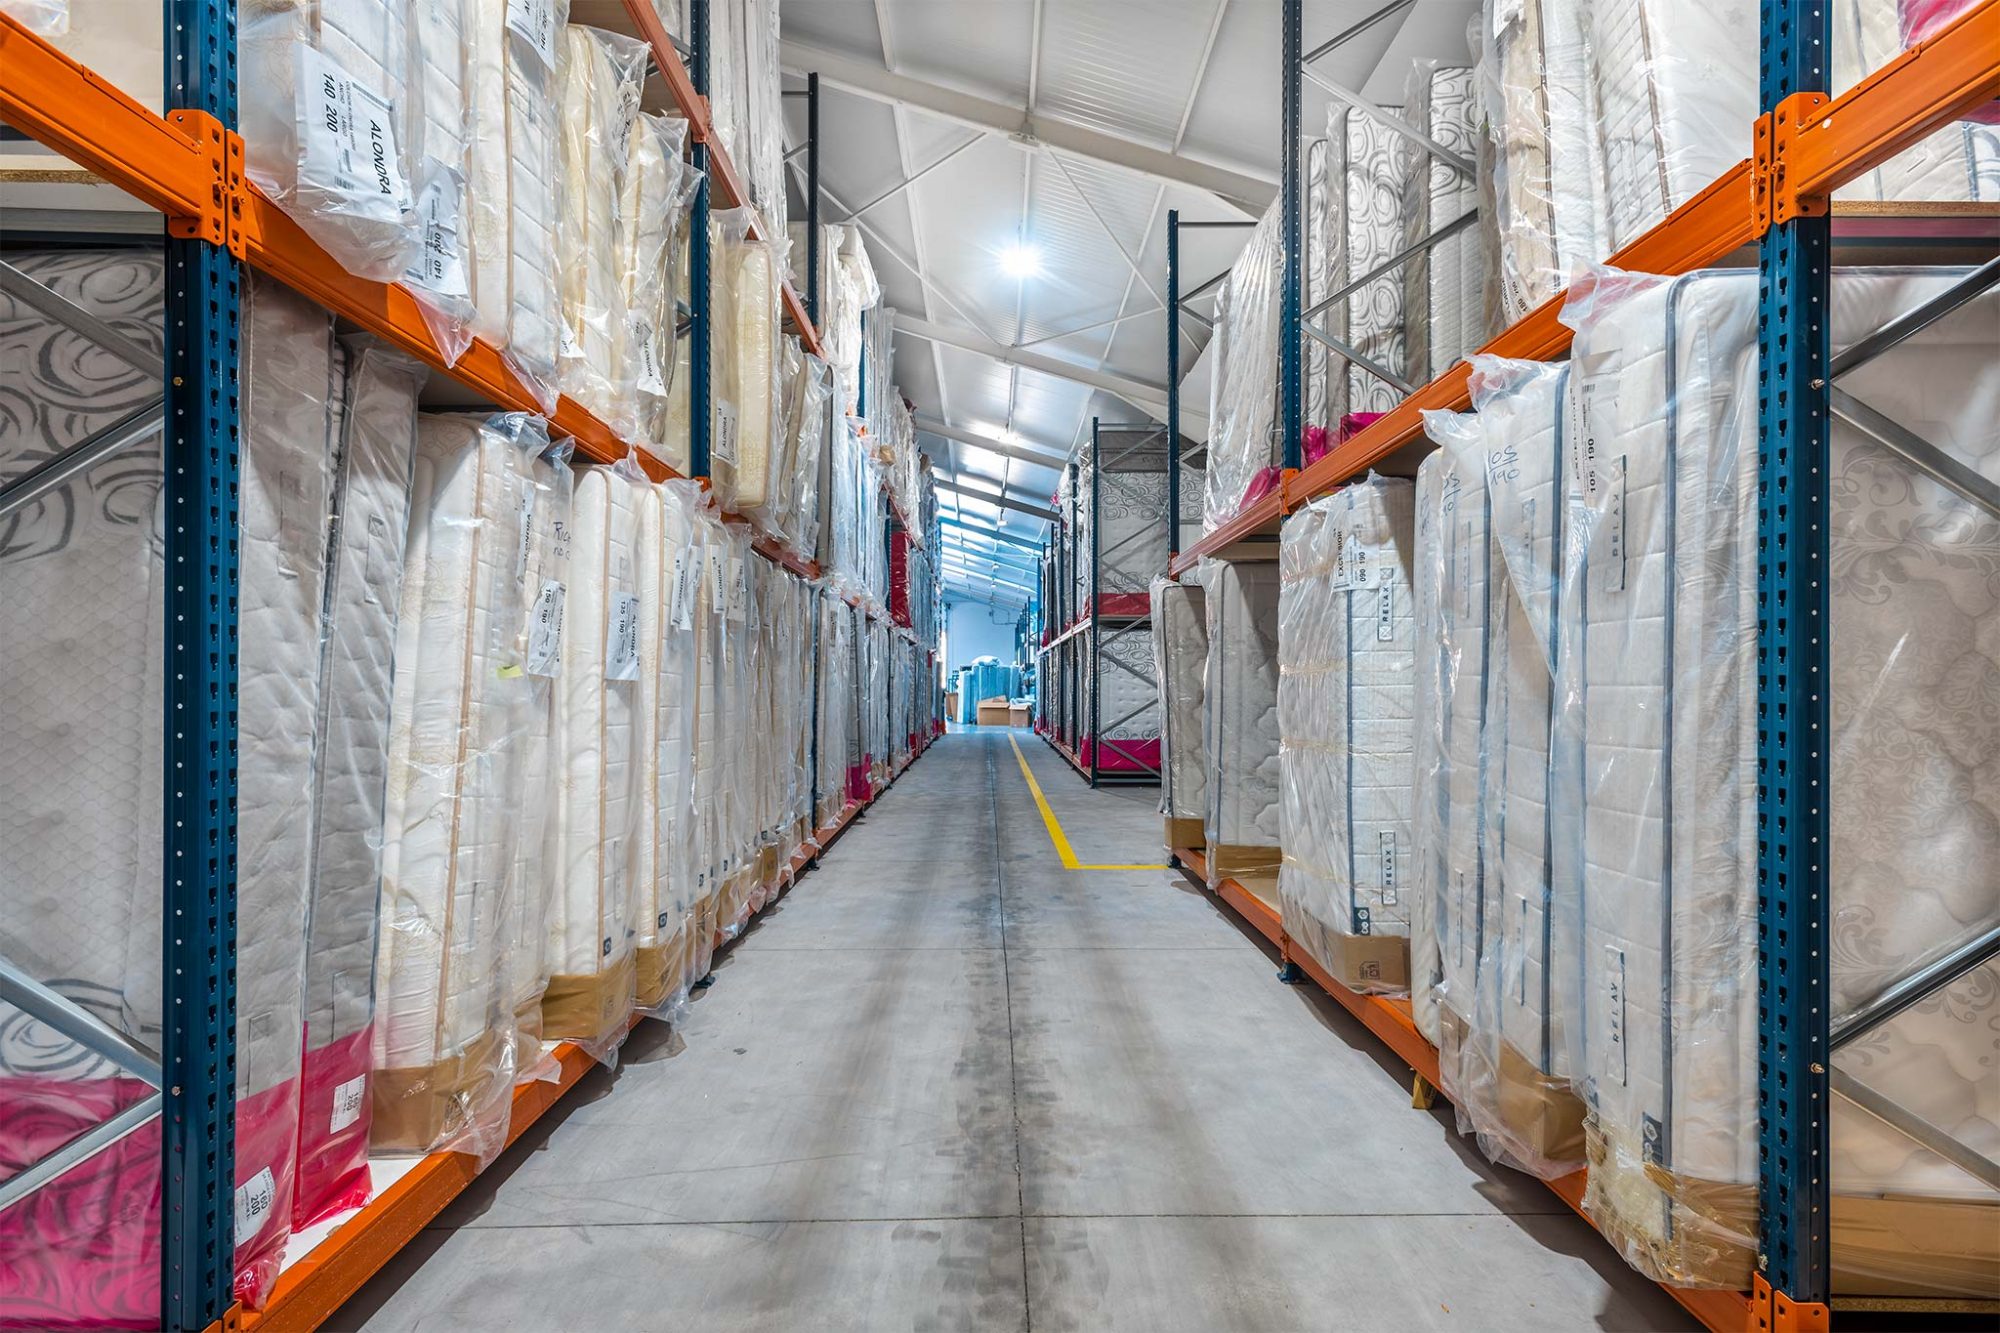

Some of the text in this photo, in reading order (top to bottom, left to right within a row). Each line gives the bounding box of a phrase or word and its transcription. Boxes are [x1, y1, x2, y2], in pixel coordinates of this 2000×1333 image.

[323, 73, 338, 133] 140 200
[370, 119, 392, 195] ALONDRA
[434, 259, 442, 280] 140
[644, 340, 653, 377] ALONDRA
[1587, 438, 1597, 493] 105 190
[1358, 551, 1367, 582] 090 190
[544, 587, 552, 604] 150
[677, 569, 685, 609] ALONDRA
[1385, 849, 1393, 886] RELAX
[1610, 981, 1620, 1044] RELAX
[250, 1194, 261, 1216] 200
